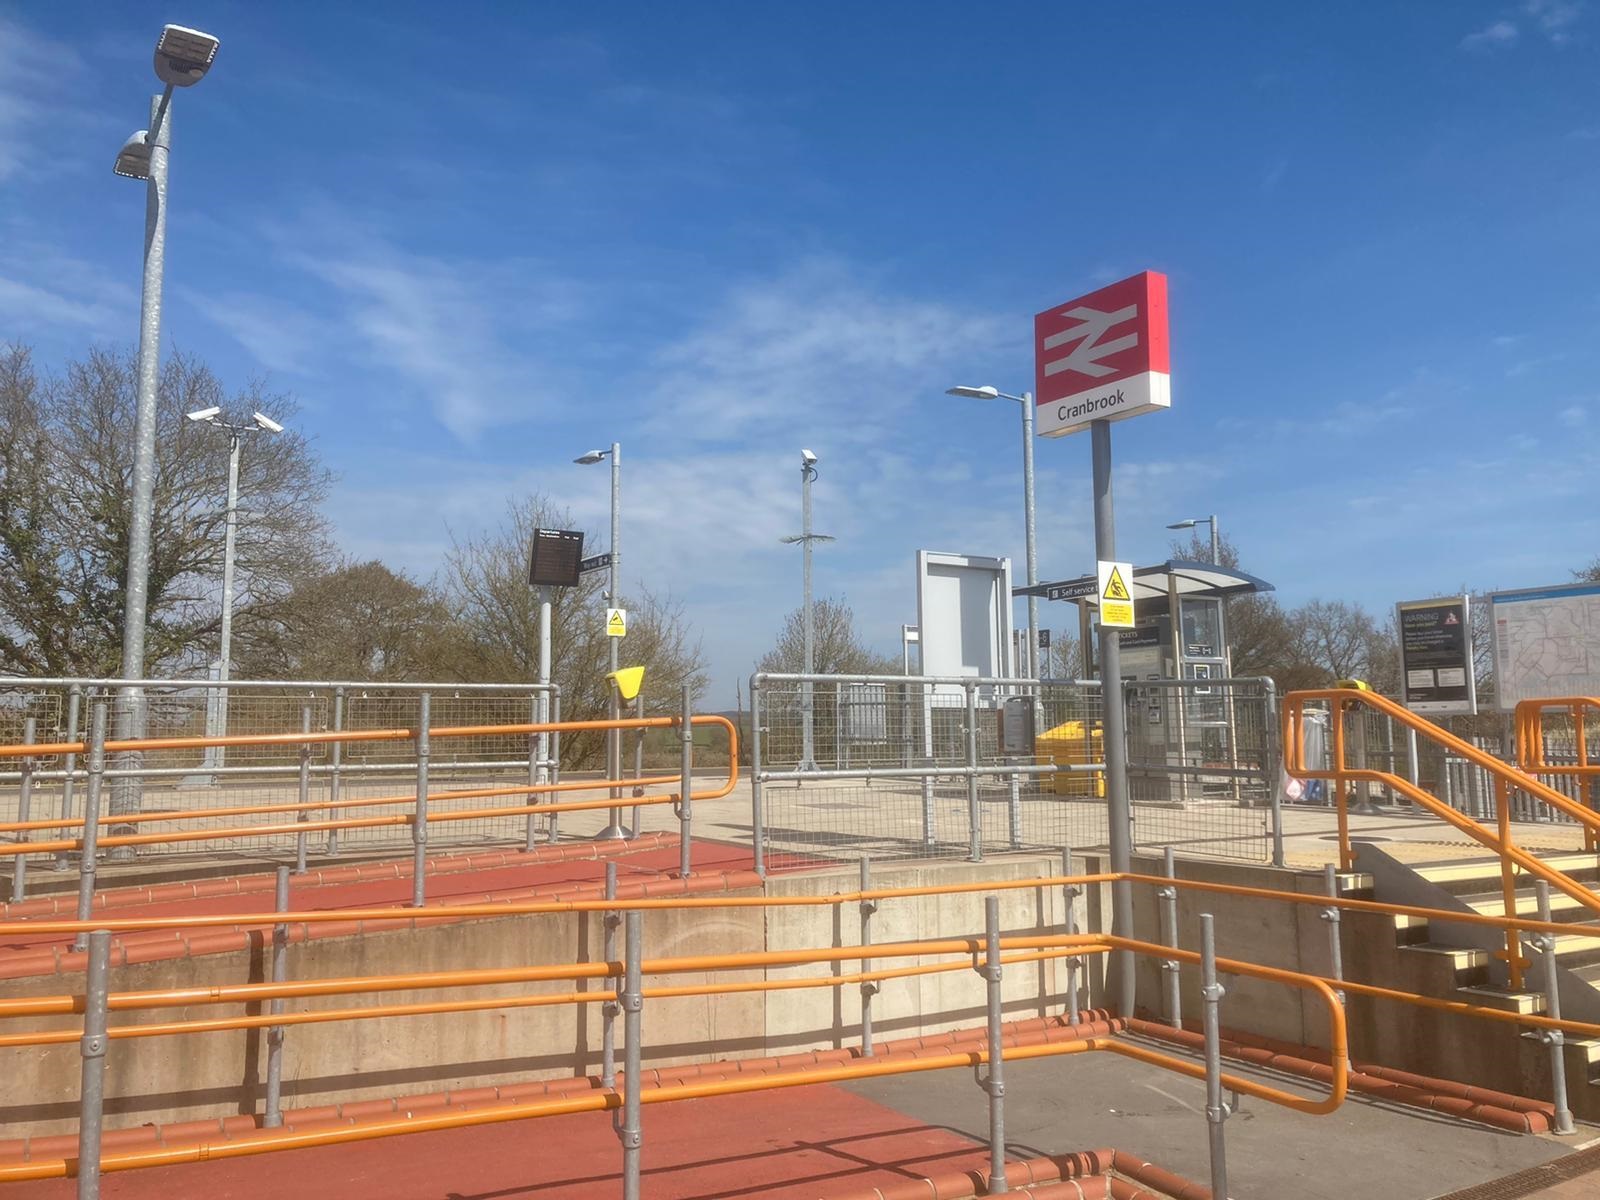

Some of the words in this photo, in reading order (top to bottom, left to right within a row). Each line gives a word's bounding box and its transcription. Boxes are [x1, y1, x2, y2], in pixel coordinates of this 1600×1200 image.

[1057, 389, 1125, 421] Cranbrook
[1062, 587, 1074, 597] Self
[1074, 585, 1095, 595] service
[1404, 612, 1439, 622] WARNING
